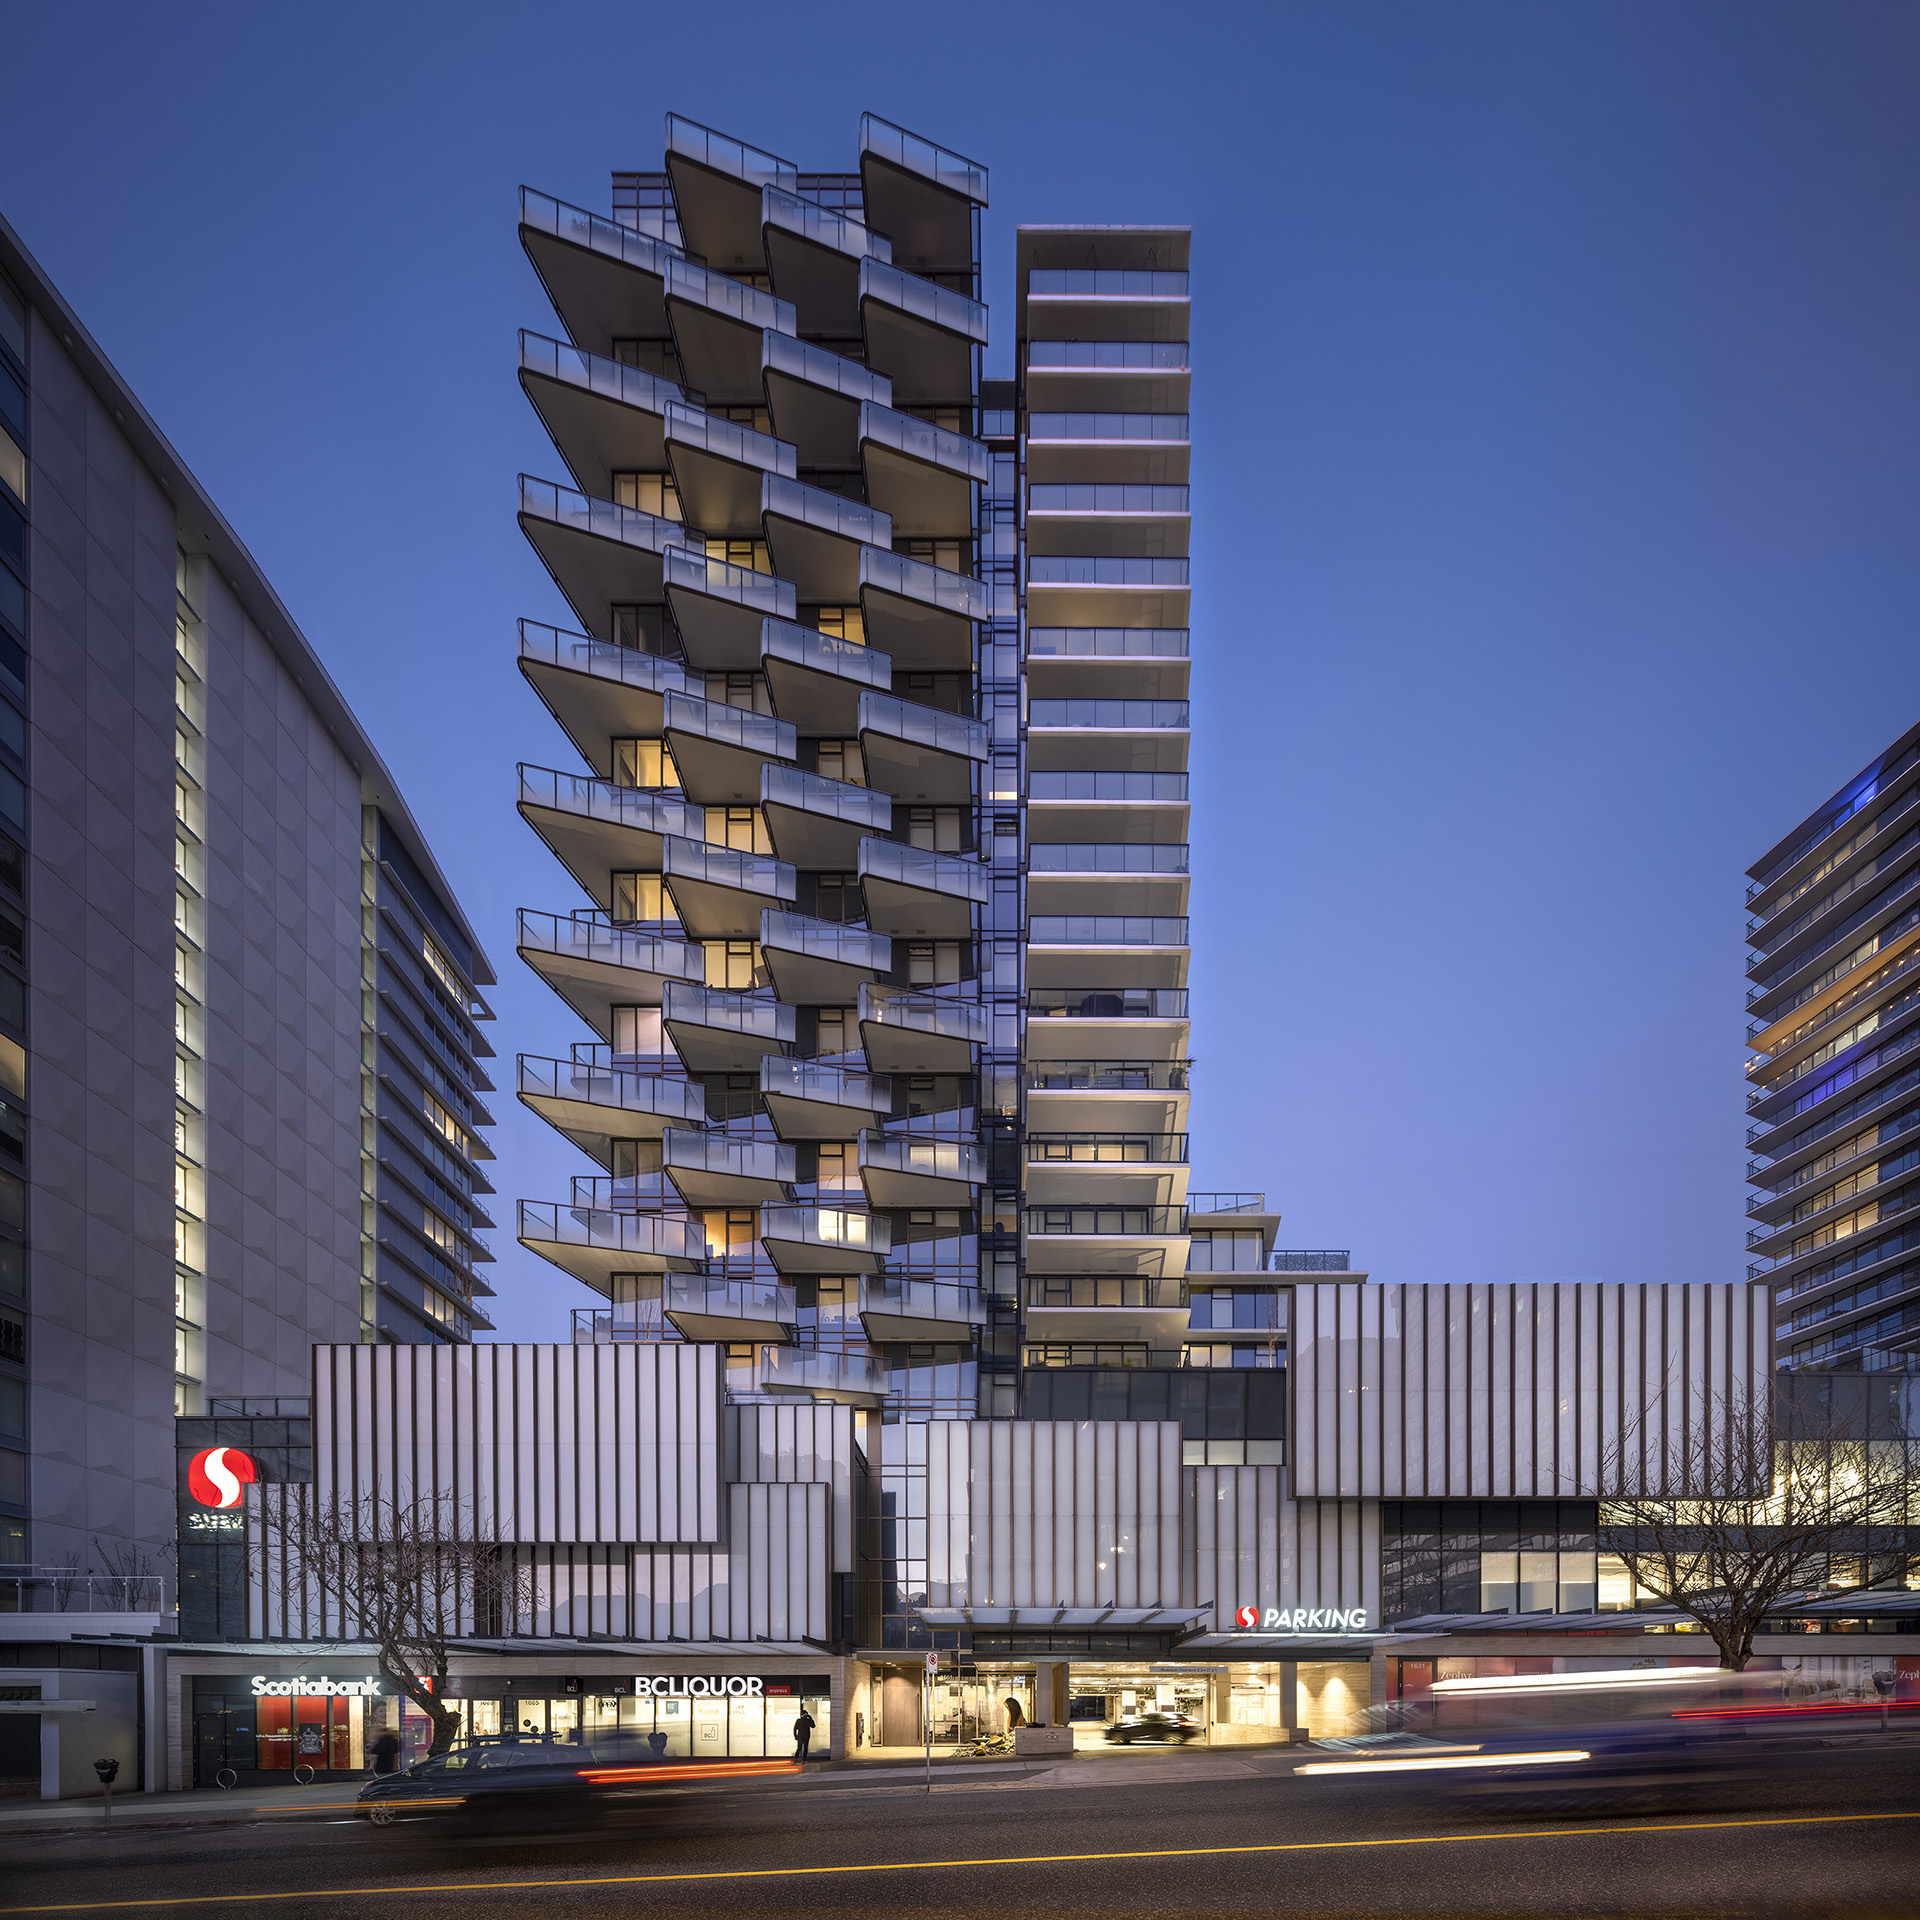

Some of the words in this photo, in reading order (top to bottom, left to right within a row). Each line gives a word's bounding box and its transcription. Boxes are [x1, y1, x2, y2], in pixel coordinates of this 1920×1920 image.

[1264, 1608, 1367, 1628] PARKING
[251, 1675, 381, 1696] Scotiabank
[635, 1676, 763, 1696] BCLIQUOR
